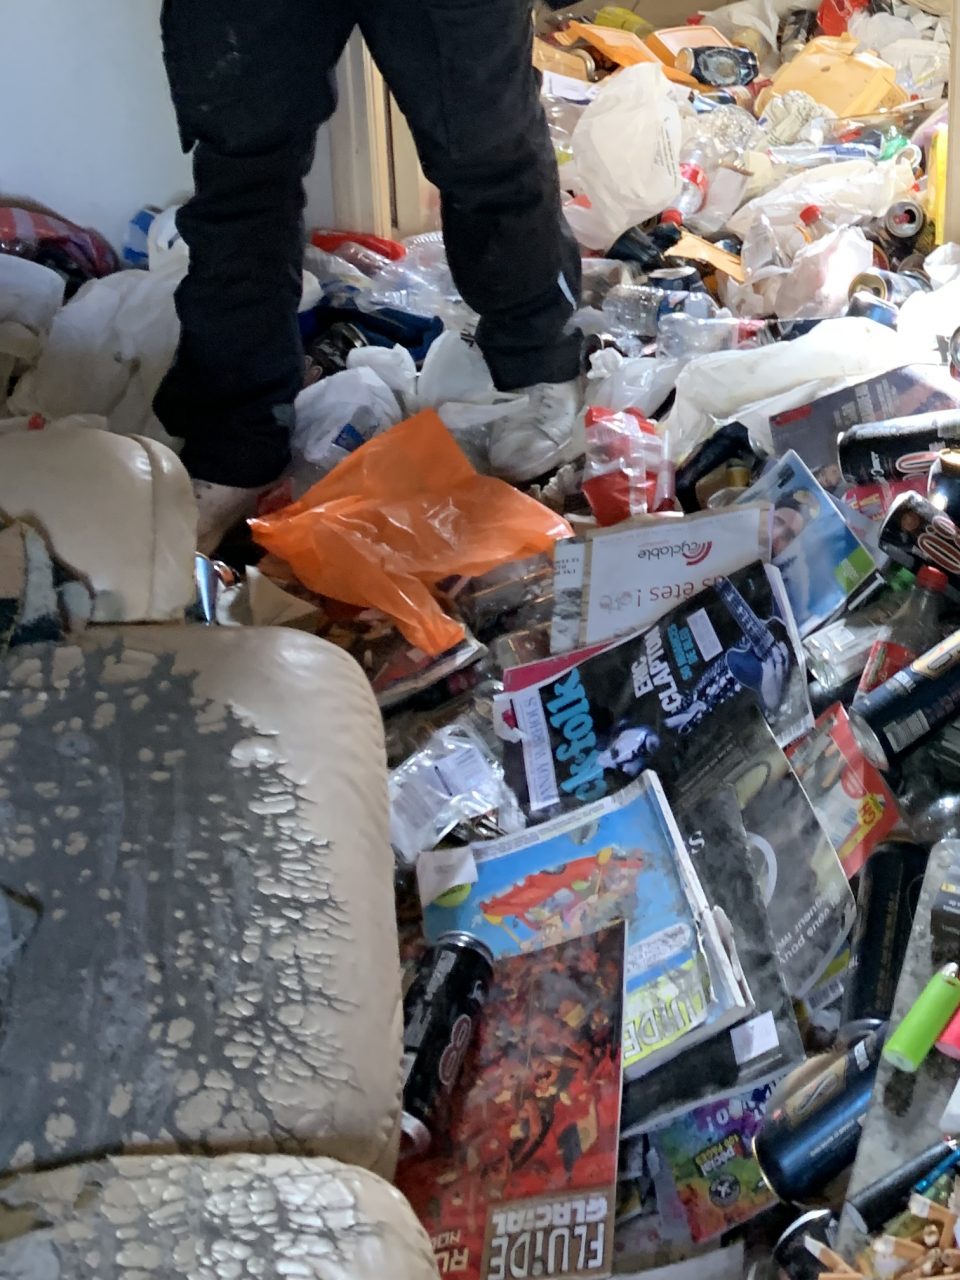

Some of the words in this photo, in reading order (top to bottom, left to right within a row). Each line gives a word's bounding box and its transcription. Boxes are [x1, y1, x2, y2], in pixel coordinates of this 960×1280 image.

[637, 539, 700, 562] cyclable
[649, 581, 696, 602] êtes
[631, 655, 654, 698] ERIC
[644, 625, 684, 713] CLAPTON
